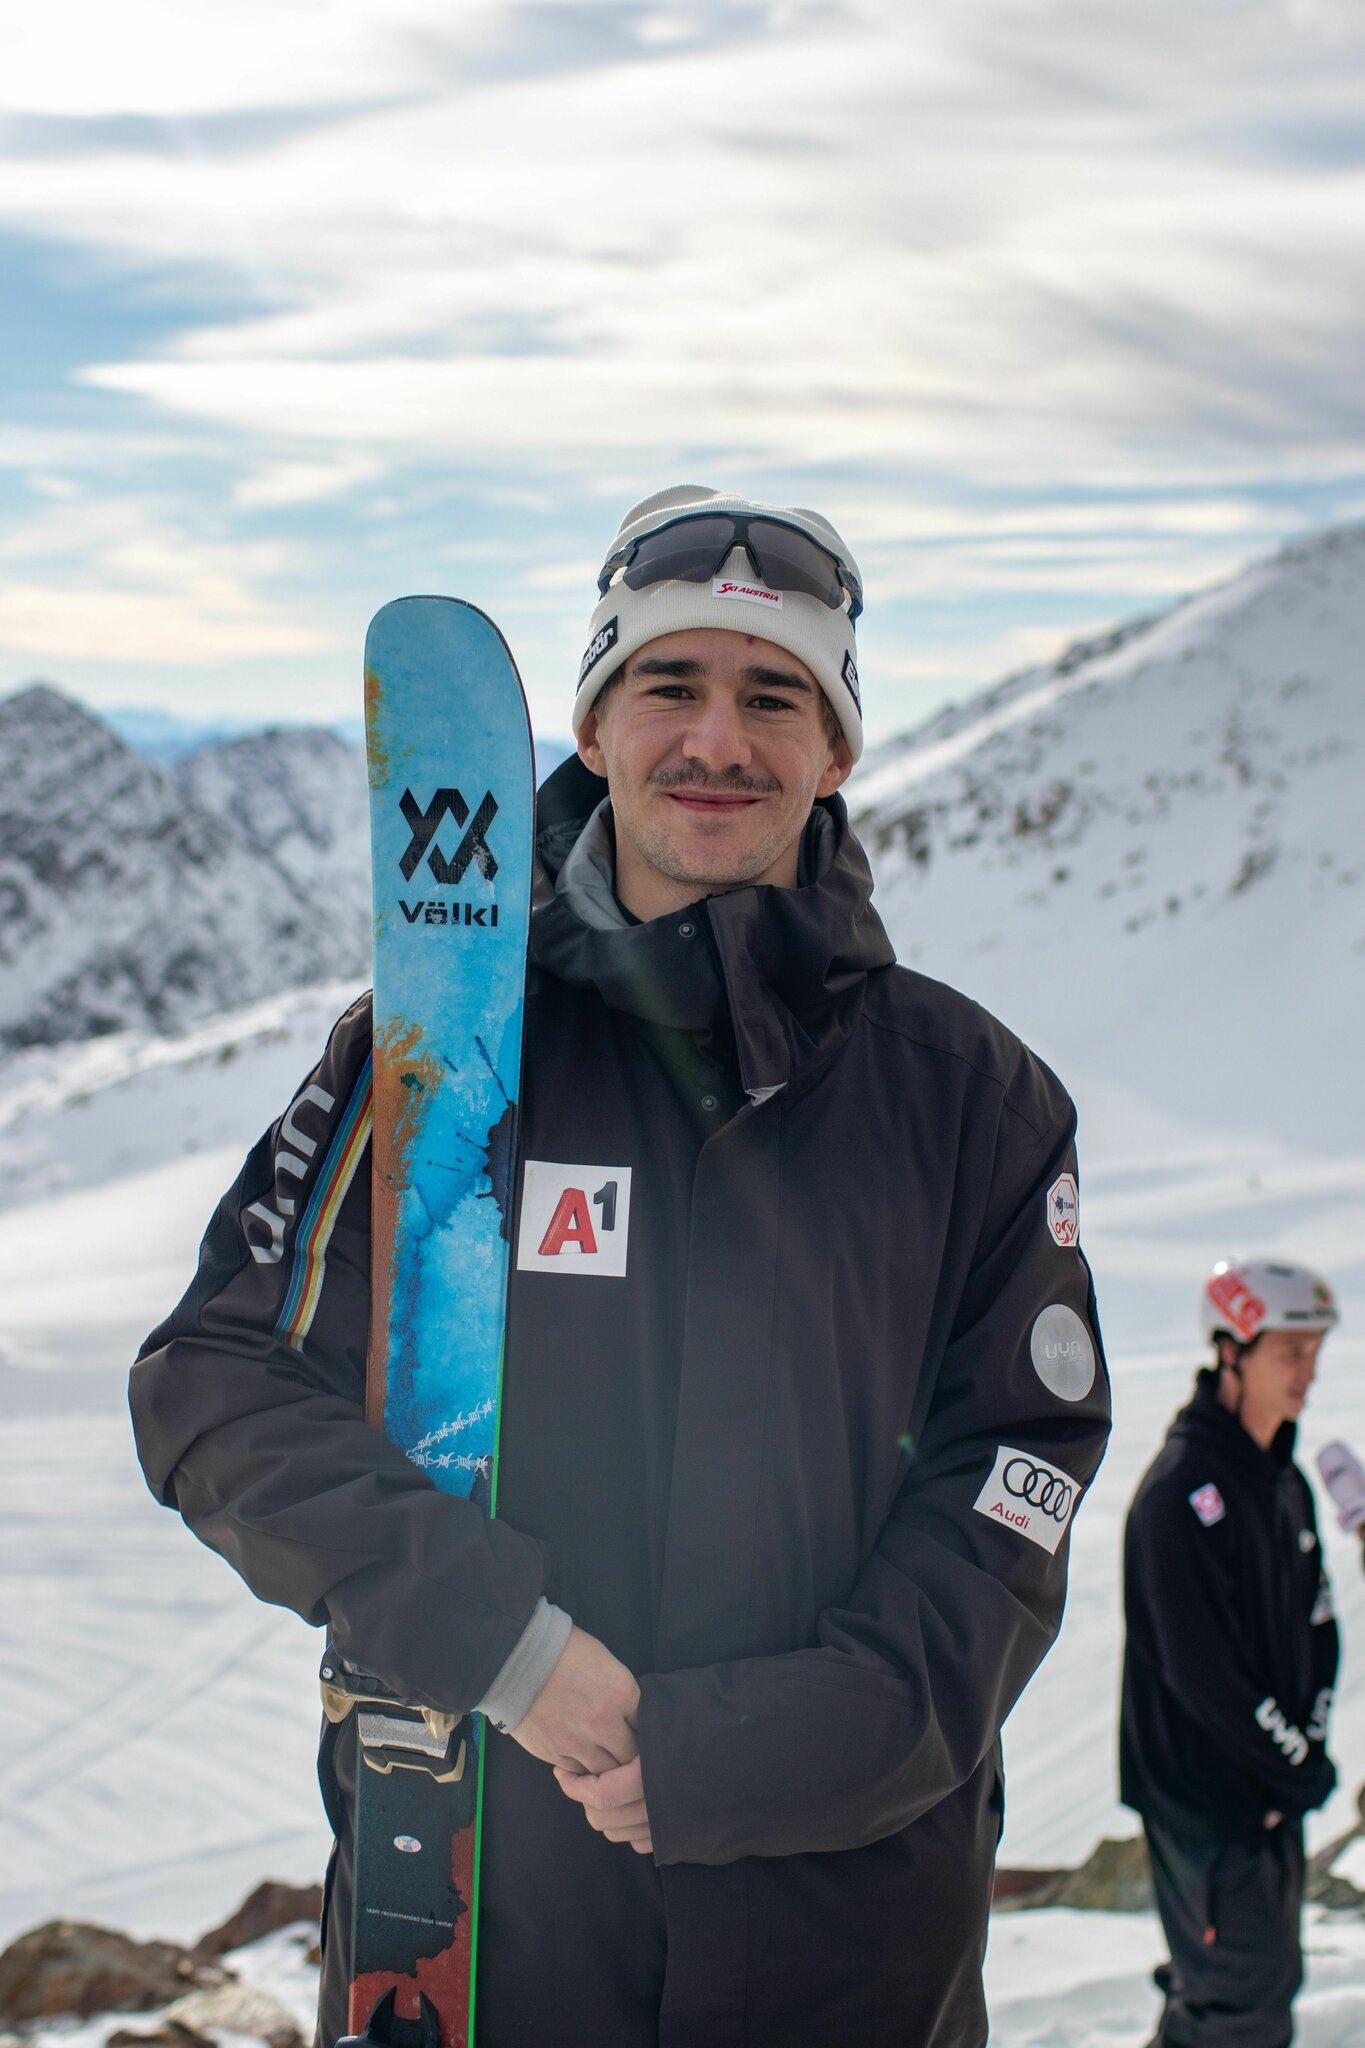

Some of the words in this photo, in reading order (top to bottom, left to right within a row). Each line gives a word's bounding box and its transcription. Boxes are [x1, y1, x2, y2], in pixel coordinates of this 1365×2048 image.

[717, 583, 738, 593] SKI
[739, 587, 779, 601] AUSTRIA
[580, 627, 614, 679] sbär
[398, 900, 498, 927] Völkl
[538, 1181, 618, 1256] A1
[990, 1502, 1031, 1529] Audi
[366, 1907, 380, 1915] team
[381, 1910, 420, 1922] recommended
[435, 1920, 453, 1928] center
